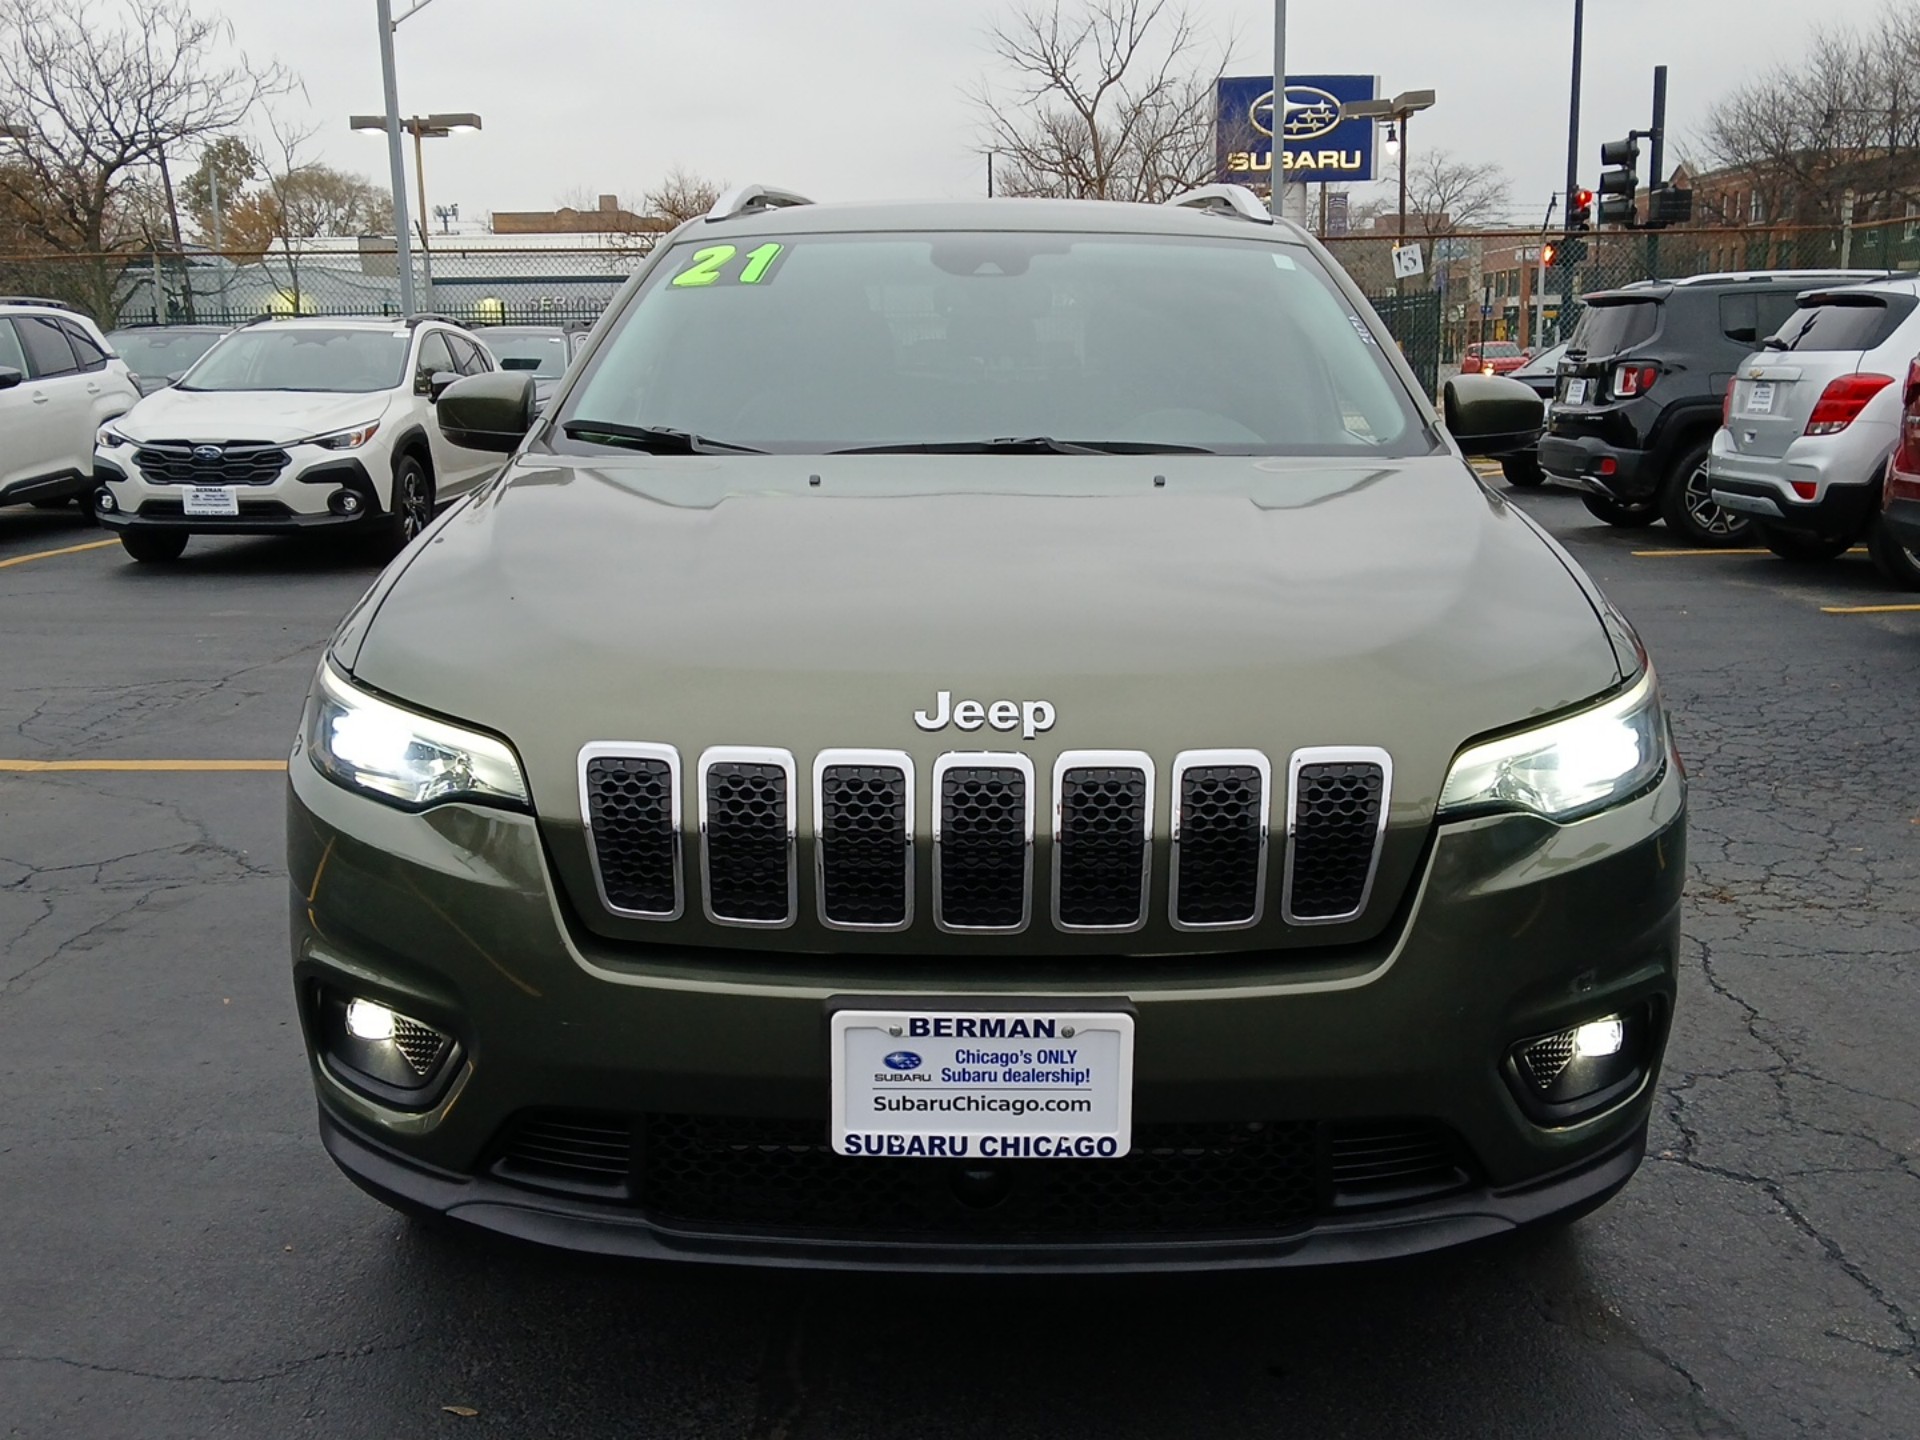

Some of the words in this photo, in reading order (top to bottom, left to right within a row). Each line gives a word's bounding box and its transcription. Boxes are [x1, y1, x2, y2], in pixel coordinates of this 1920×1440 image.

[1228, 150, 1361, 171] SUBARU
[914, 691, 1056, 740] Jeep
[909, 1018, 1055, 1038] BERMAN
[1036, 1050, 1078, 1065] ONLY
[875, 1074, 931, 1082] SUBARU
[941, 1068, 998, 1083] Subaru
[1002, 1068, 1090, 1085] dealership!
[873, 1095, 1091, 1115] SubaruChicago.com
[844, 1134, 968, 1156] SUBARU
[979, 1136, 1118, 1157] CHICAGO
